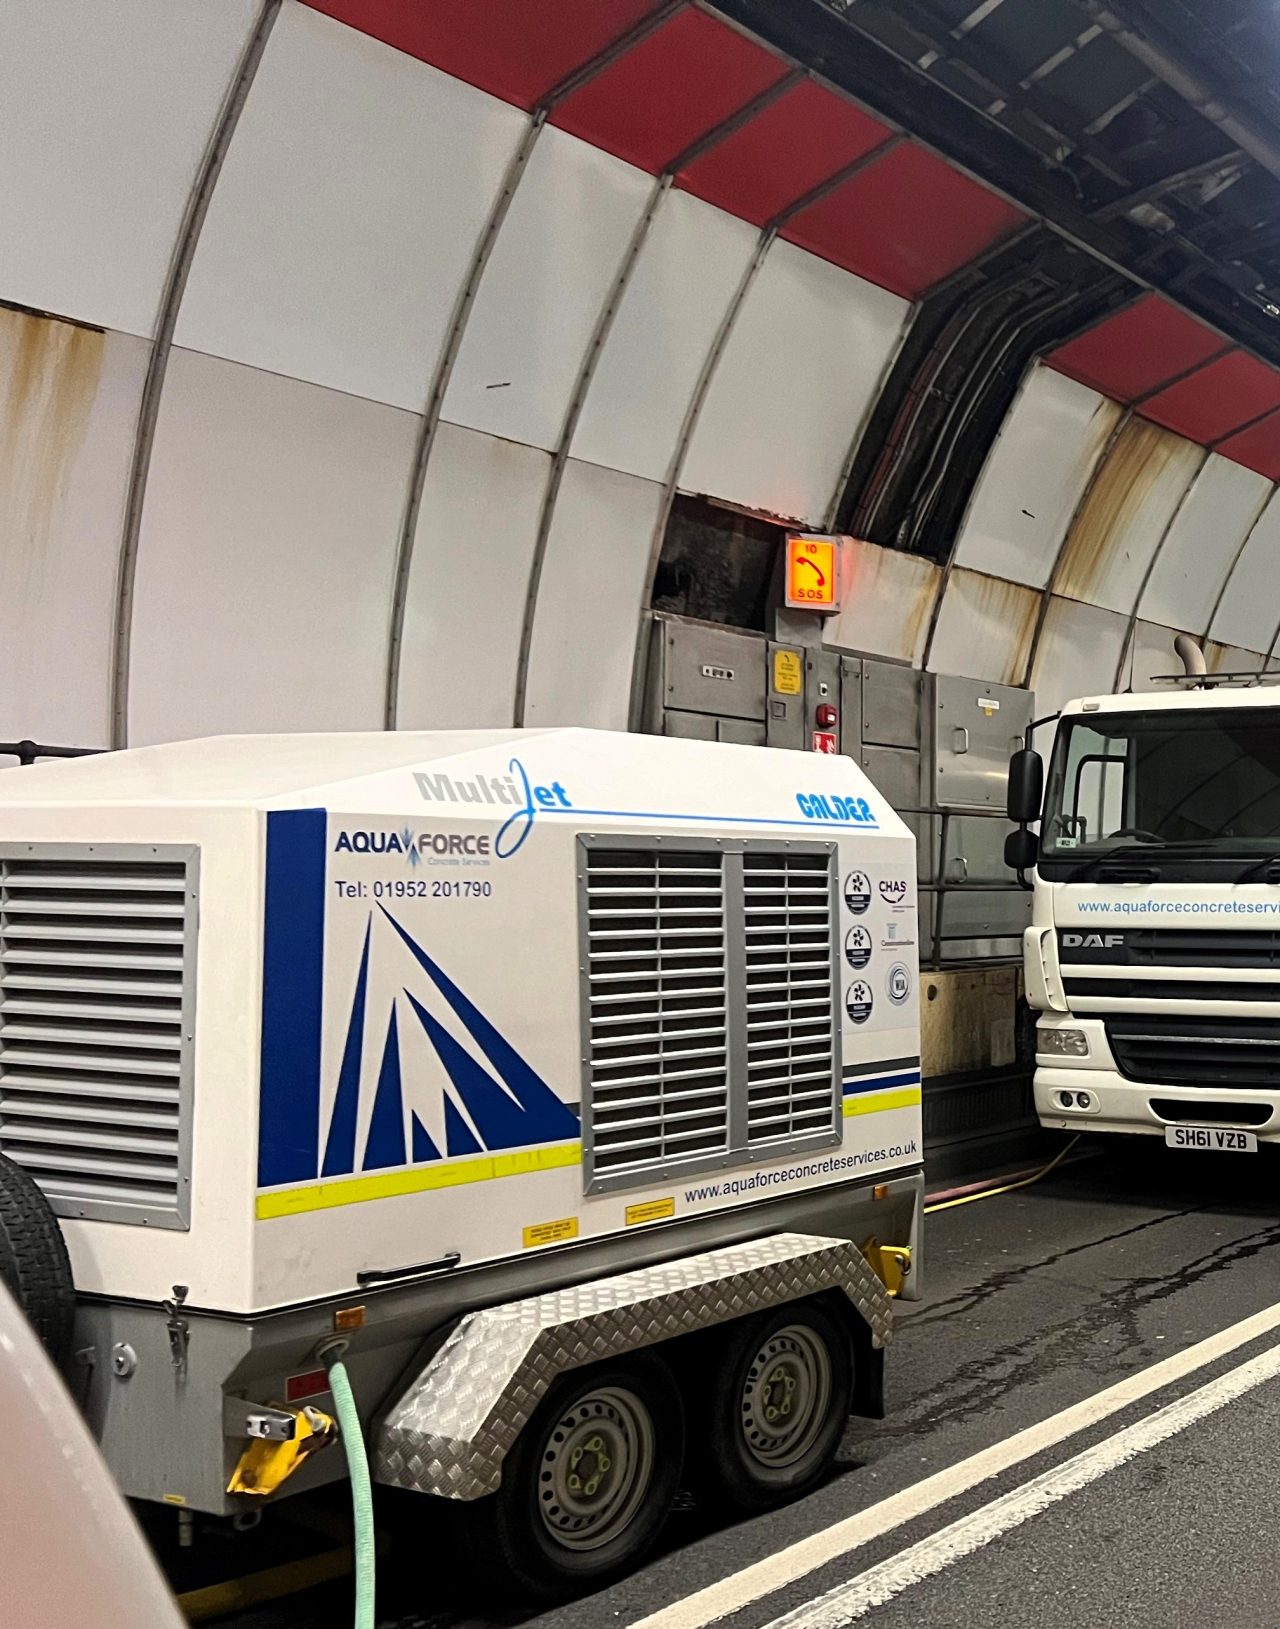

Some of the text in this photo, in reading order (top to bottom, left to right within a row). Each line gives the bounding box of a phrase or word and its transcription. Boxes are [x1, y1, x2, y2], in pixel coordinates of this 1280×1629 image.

[797, 588, 823, 600] SOS
[334, 831, 490, 856] AQUA FORCE
[334, 880, 492, 898] Tel: 01952 201790
[879, 880, 907, 893] CHAS
[1062, 934, 1124, 948] DAF
[1175, 1129, 1248, 1149] SH61 VZB
[685, 1140, 917, 1203] www.aquaforceconcreteservices.co.uk
